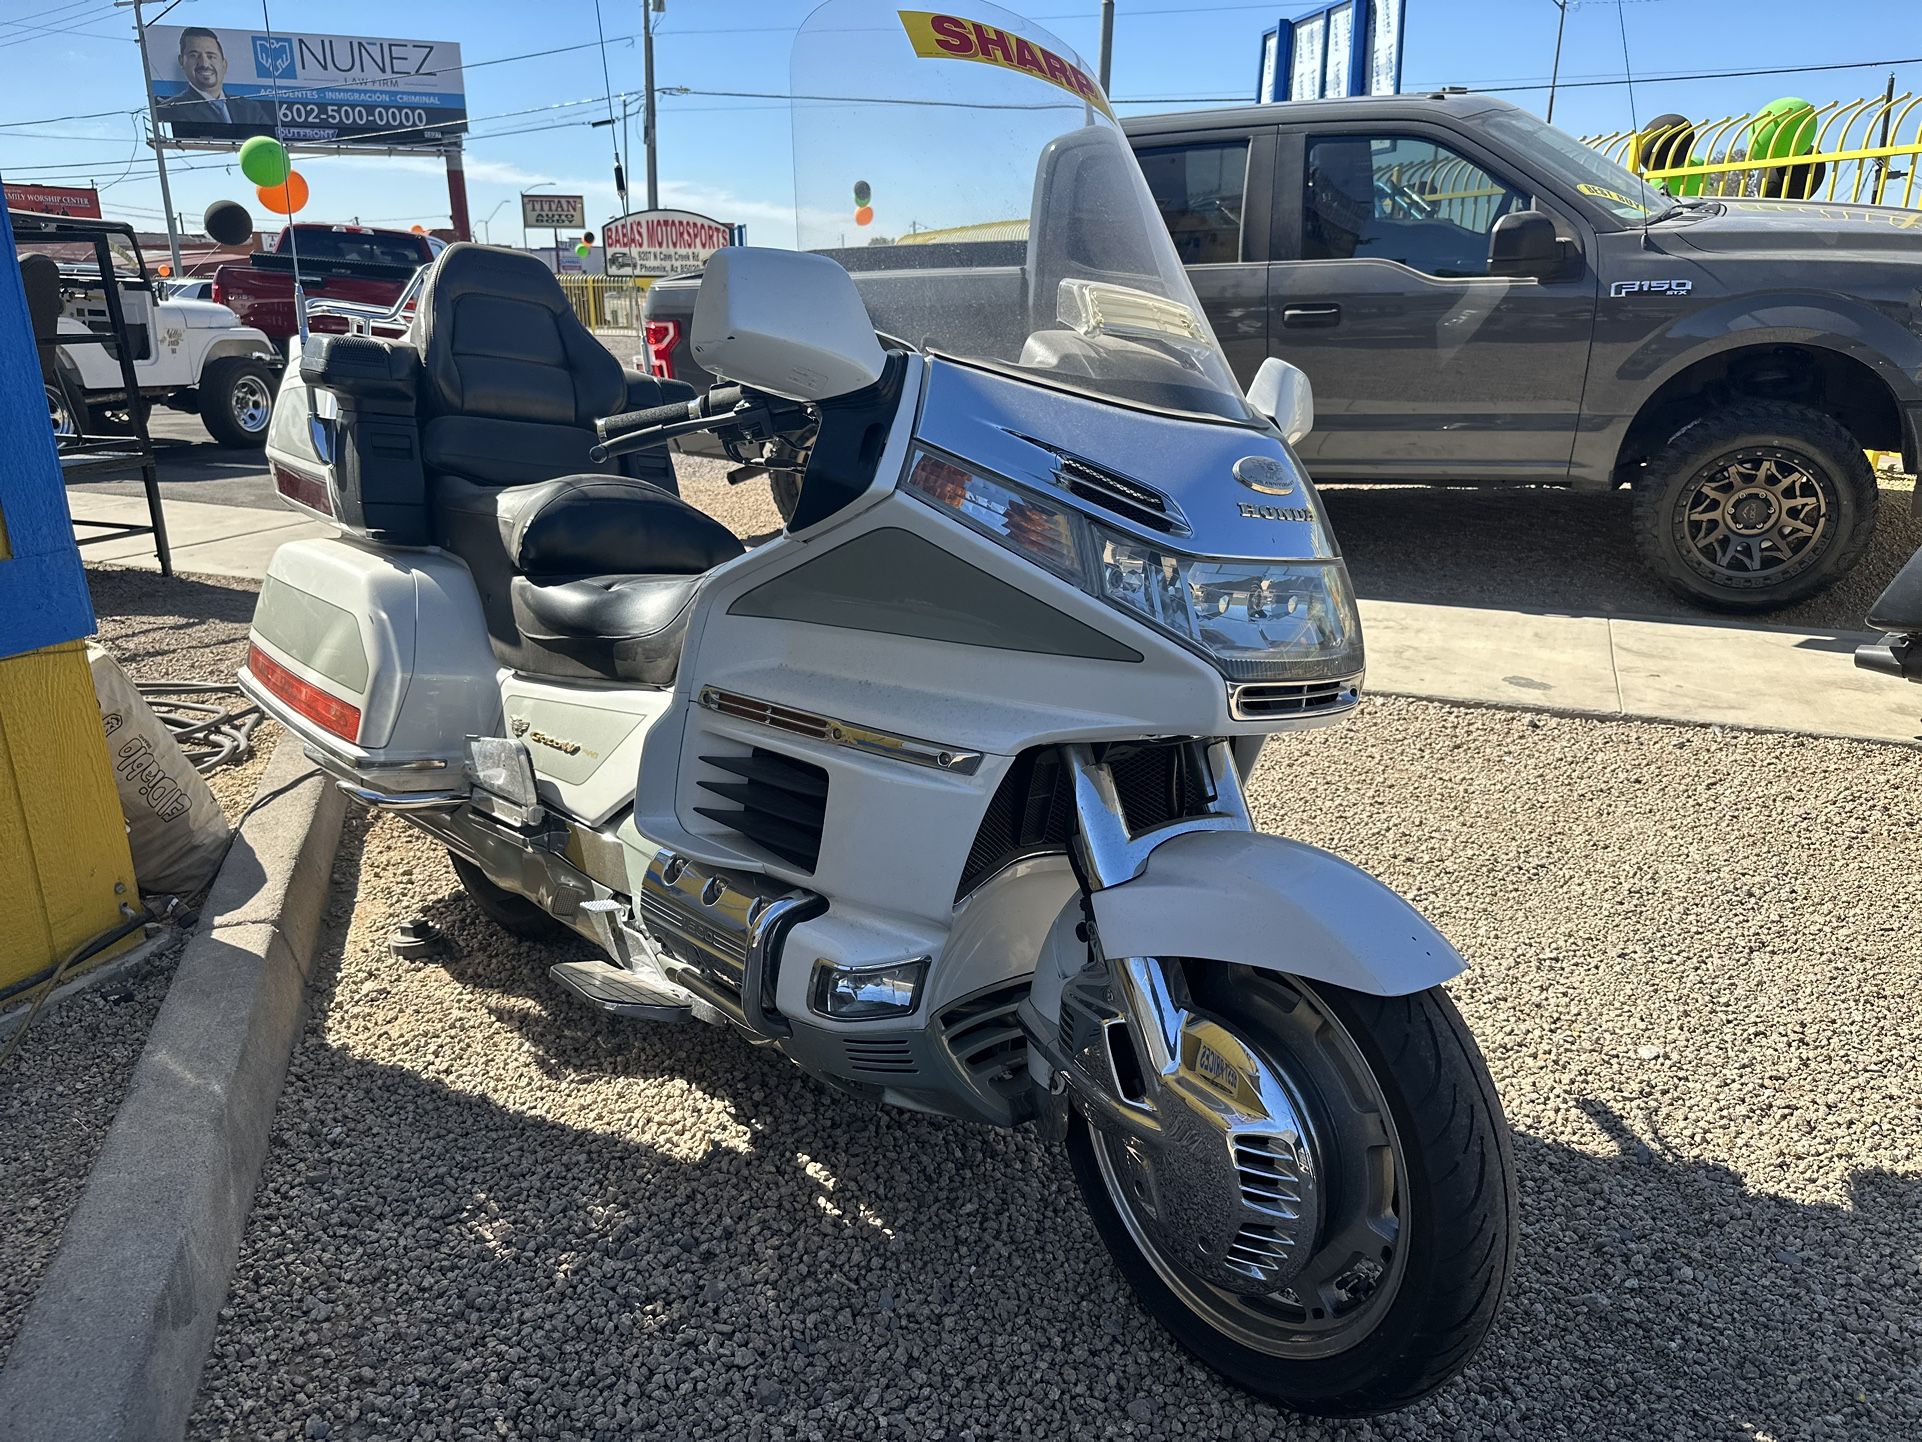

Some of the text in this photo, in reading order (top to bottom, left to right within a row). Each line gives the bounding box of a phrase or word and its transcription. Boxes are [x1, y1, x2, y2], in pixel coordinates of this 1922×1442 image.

[930, 15, 1099, 101] SHARP
[372, 79, 399, 87] FIRM
[397, 94, 440, 104] CRIMINAL
[279, 103, 427, 127] 602-500-0000
[278, 128, 335, 138] OUTFRONT
[4, 192, 26, 200] AMILY
[27, 194, 61, 203] WORSHIP
[62, 196, 89, 205] CENTER
[1587, 185, 1612, 199] BEST
[527, 199, 577, 212] TITAN
[646, 219, 728, 250] MOTORSPORTS
[660, 251, 673, 261] Cave
[674, 251, 690, 261] Creek
[117, 738, 178, 808] Diablo
